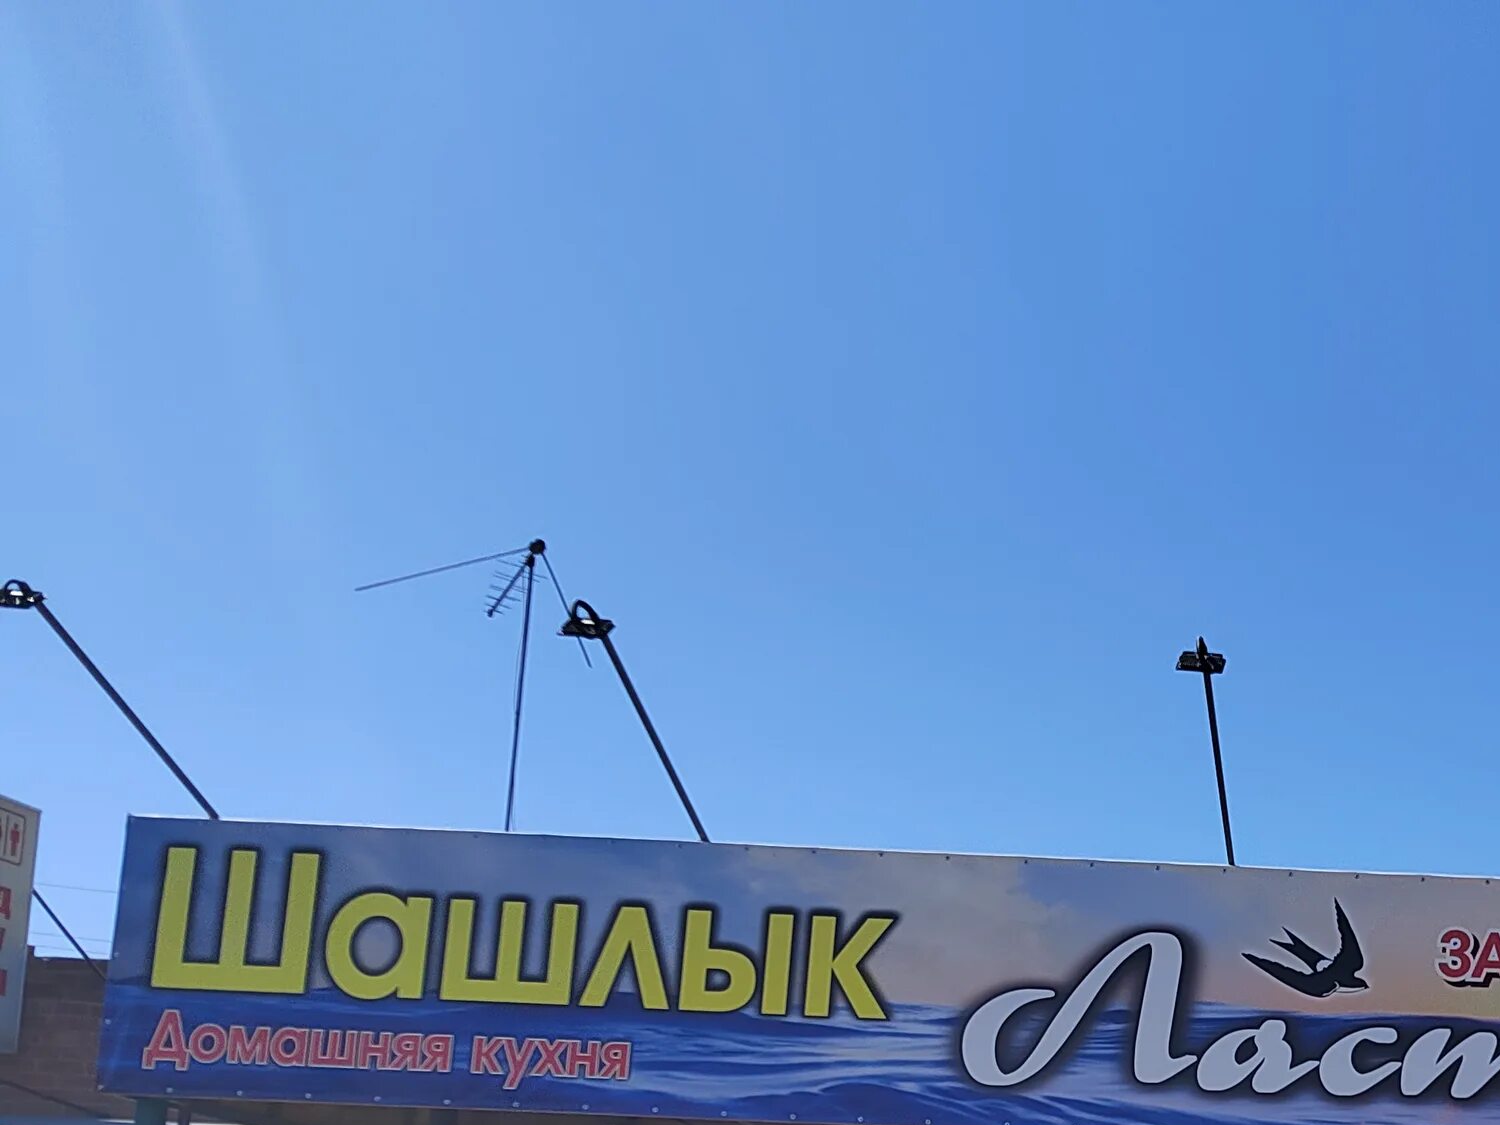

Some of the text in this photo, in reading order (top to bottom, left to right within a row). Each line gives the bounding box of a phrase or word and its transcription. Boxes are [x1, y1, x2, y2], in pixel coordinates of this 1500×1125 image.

[150, 846, 896, 1021] Шашлык
[141, 1008, 632, 1090] Домашняя кухня
